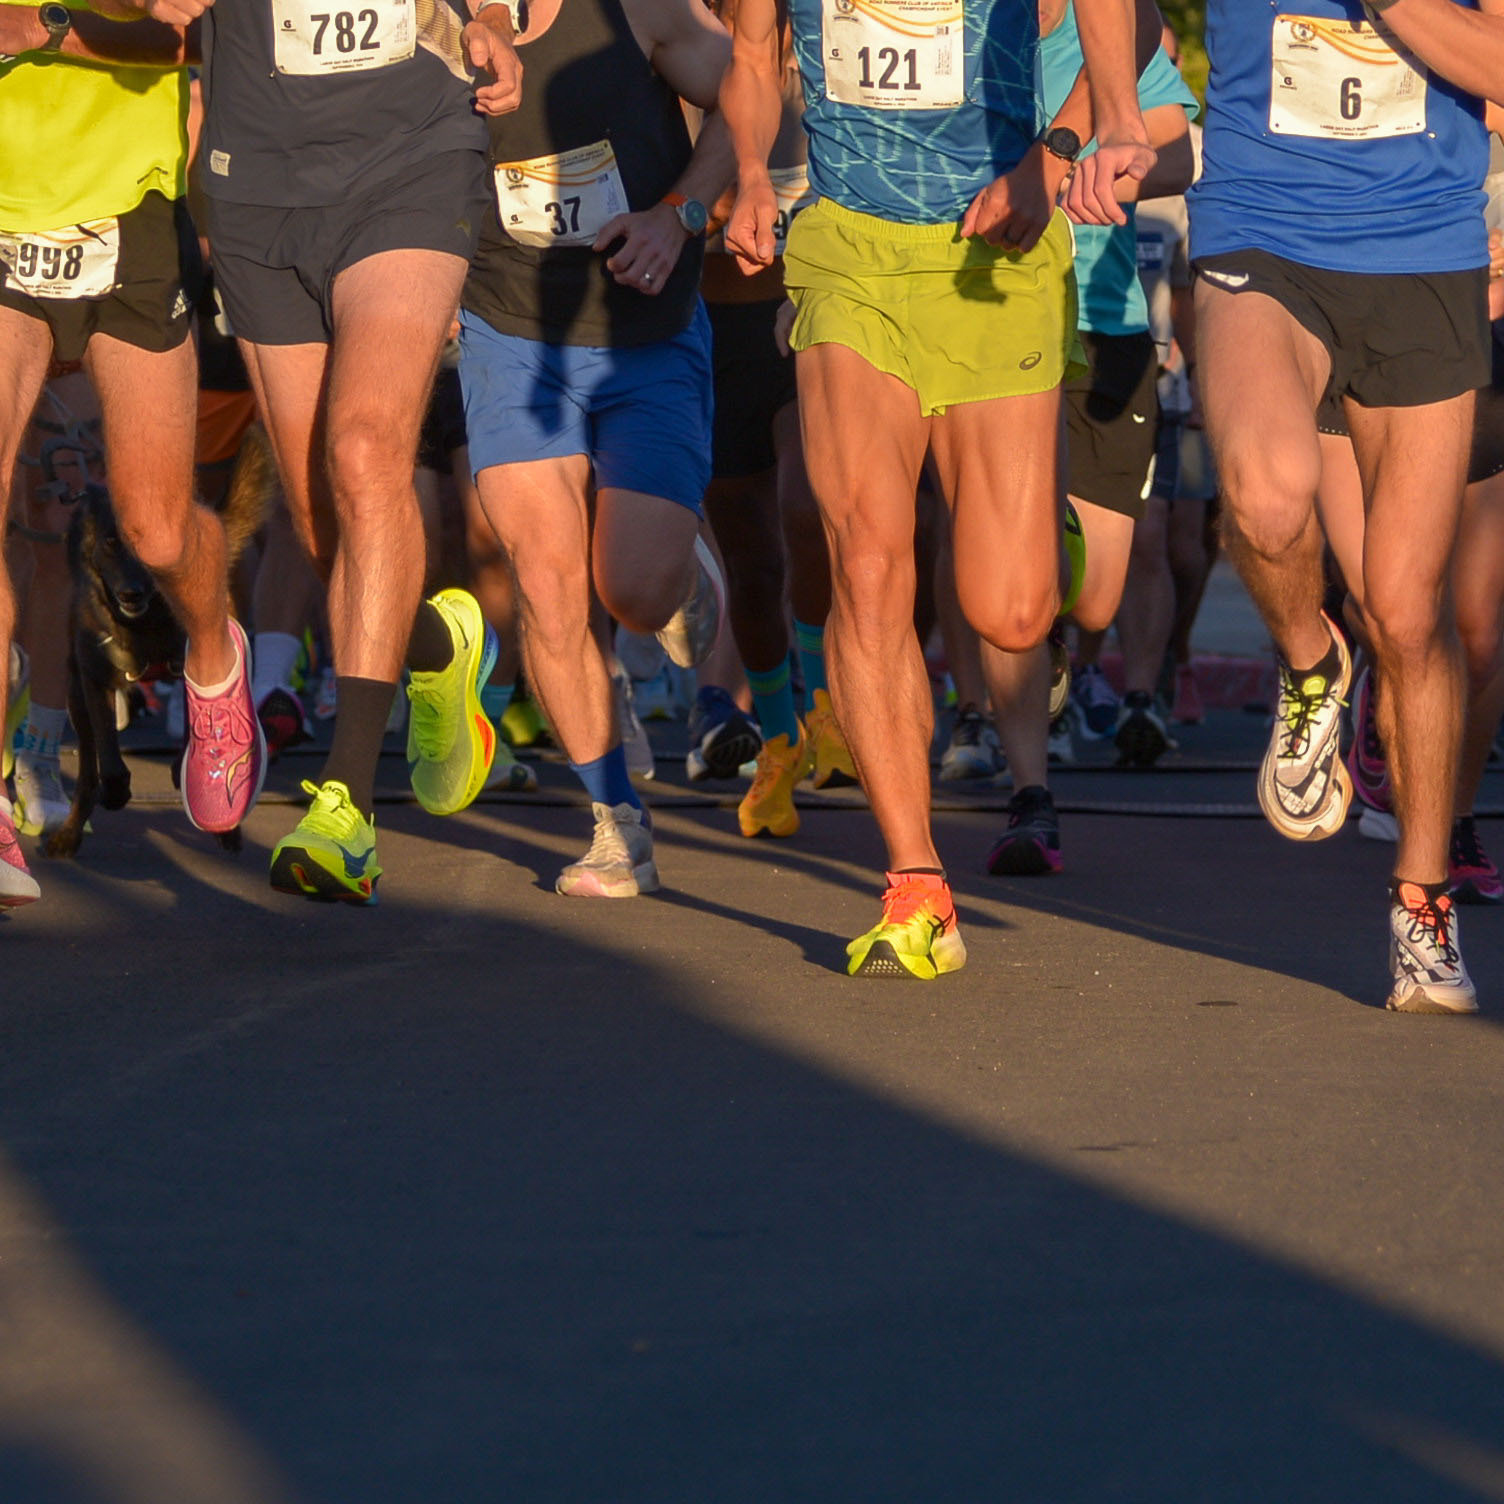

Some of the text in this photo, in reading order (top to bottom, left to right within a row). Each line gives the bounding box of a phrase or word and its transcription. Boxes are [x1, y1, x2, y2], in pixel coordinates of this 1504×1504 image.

[310, 9, 381, 55] 782
[857, 46, 922, 90] 121
[1339, 76, 1363, 120] 6
[544, 195, 581, 236] 37
[18, 242, 84, 280] 998
